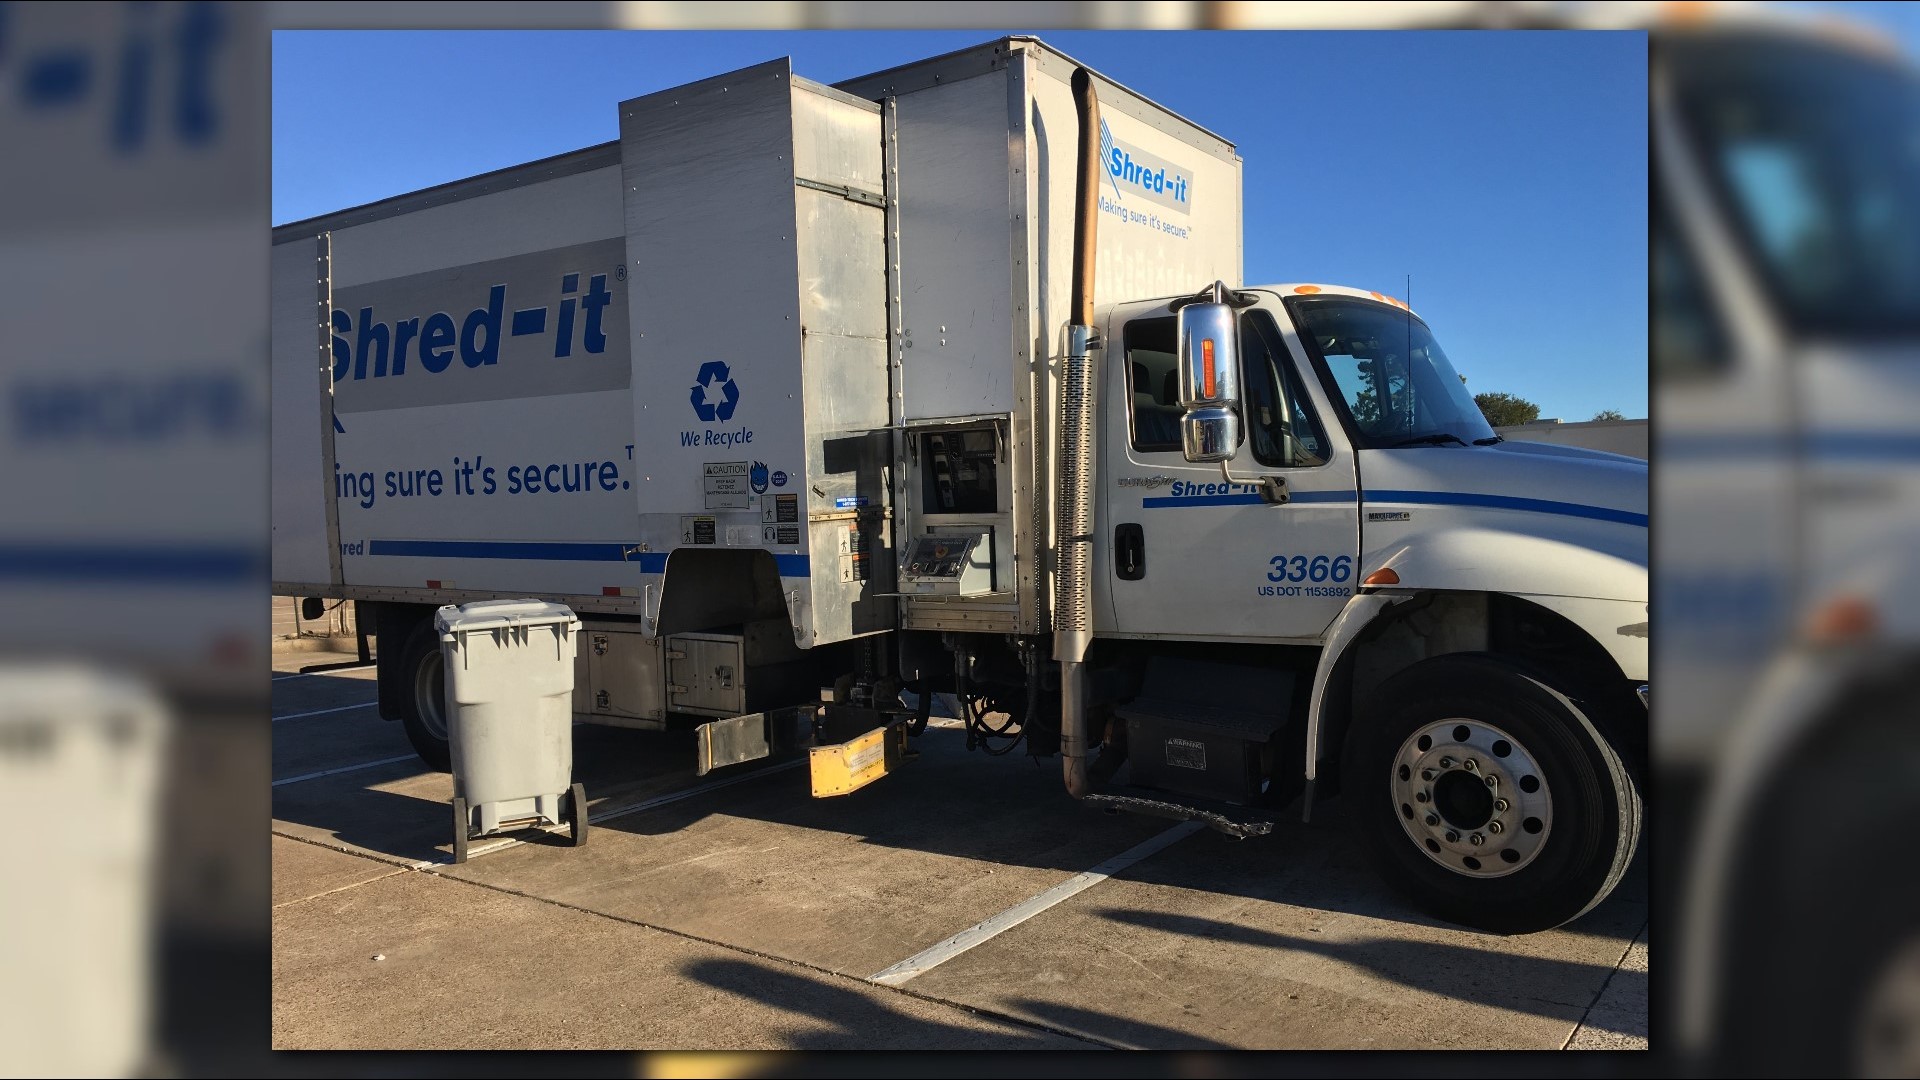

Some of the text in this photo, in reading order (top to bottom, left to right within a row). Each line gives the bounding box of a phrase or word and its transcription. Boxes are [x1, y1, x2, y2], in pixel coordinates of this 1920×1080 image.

[1110, 147, 1187, 203] Shred-it
[1130, 210, 1147, 226] sure
[1149, 213, 1161, 230] it's
[331, 272, 612, 383] Shred-it
[680, 426, 753, 450] We Recycle
[712, 465, 746, 475] CAUTION
[335, 462, 375, 509] ing
[385, 468, 443, 498] sure
[454, 456, 497, 497] it's
[341, 540, 364, 556] red
[1267, 555, 1352, 583] 3366
[1258, 586, 1351, 597] US DOT 1153892
